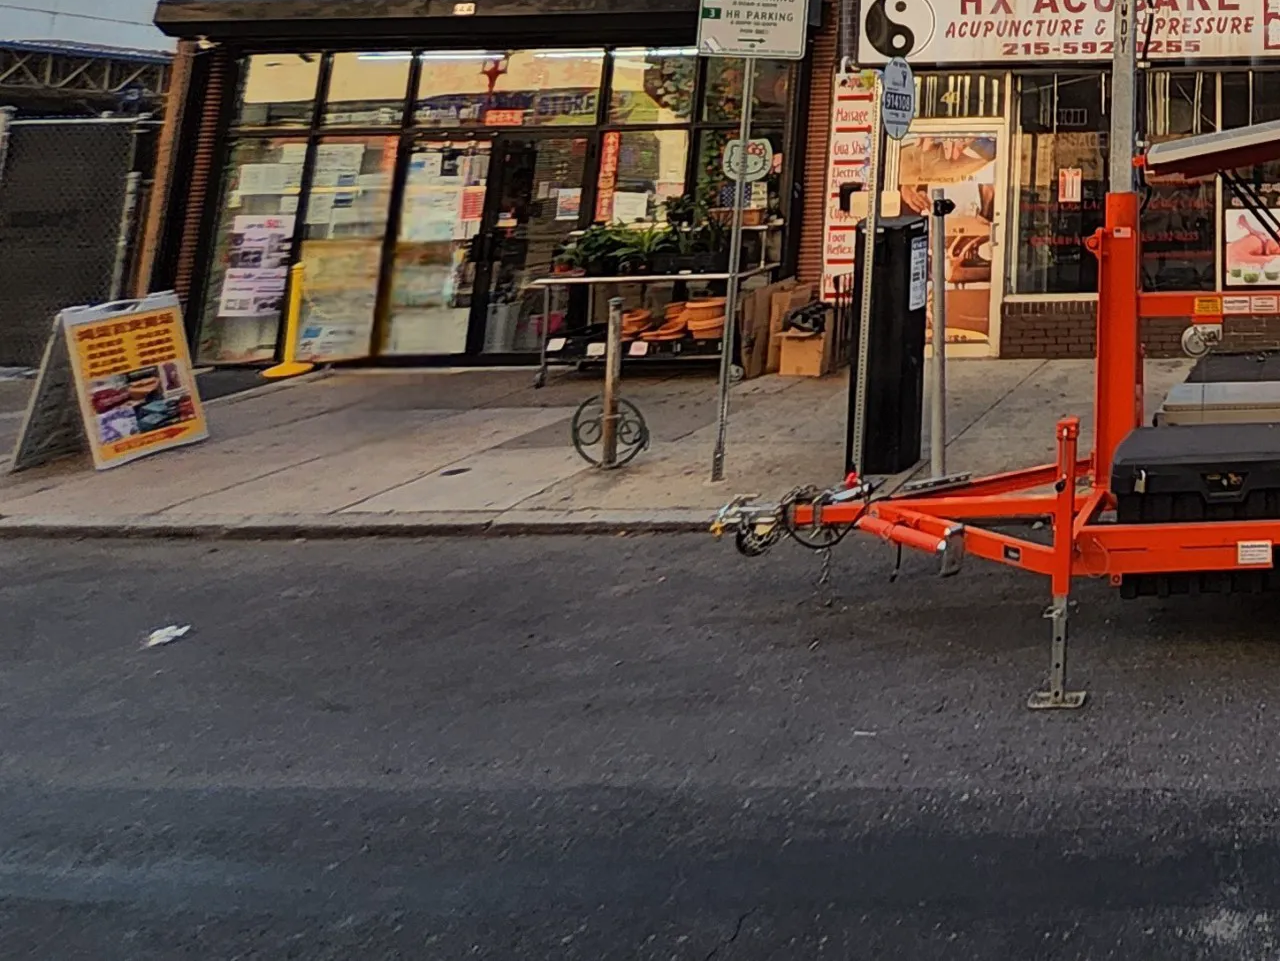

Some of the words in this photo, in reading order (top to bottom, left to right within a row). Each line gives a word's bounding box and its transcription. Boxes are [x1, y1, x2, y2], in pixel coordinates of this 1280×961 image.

[708, 8, 716, 18] 3
[725, 9, 741, 18] HR
[746, 10, 794, 22] PARKING
[945, 18, 1085, 38] ACUPUNCTURE
[1095, 17, 1107, 35] &
[835, 107, 869, 125] Massage
[833, 140, 850, 155] Gua
[828, 231, 847, 243] Foot
